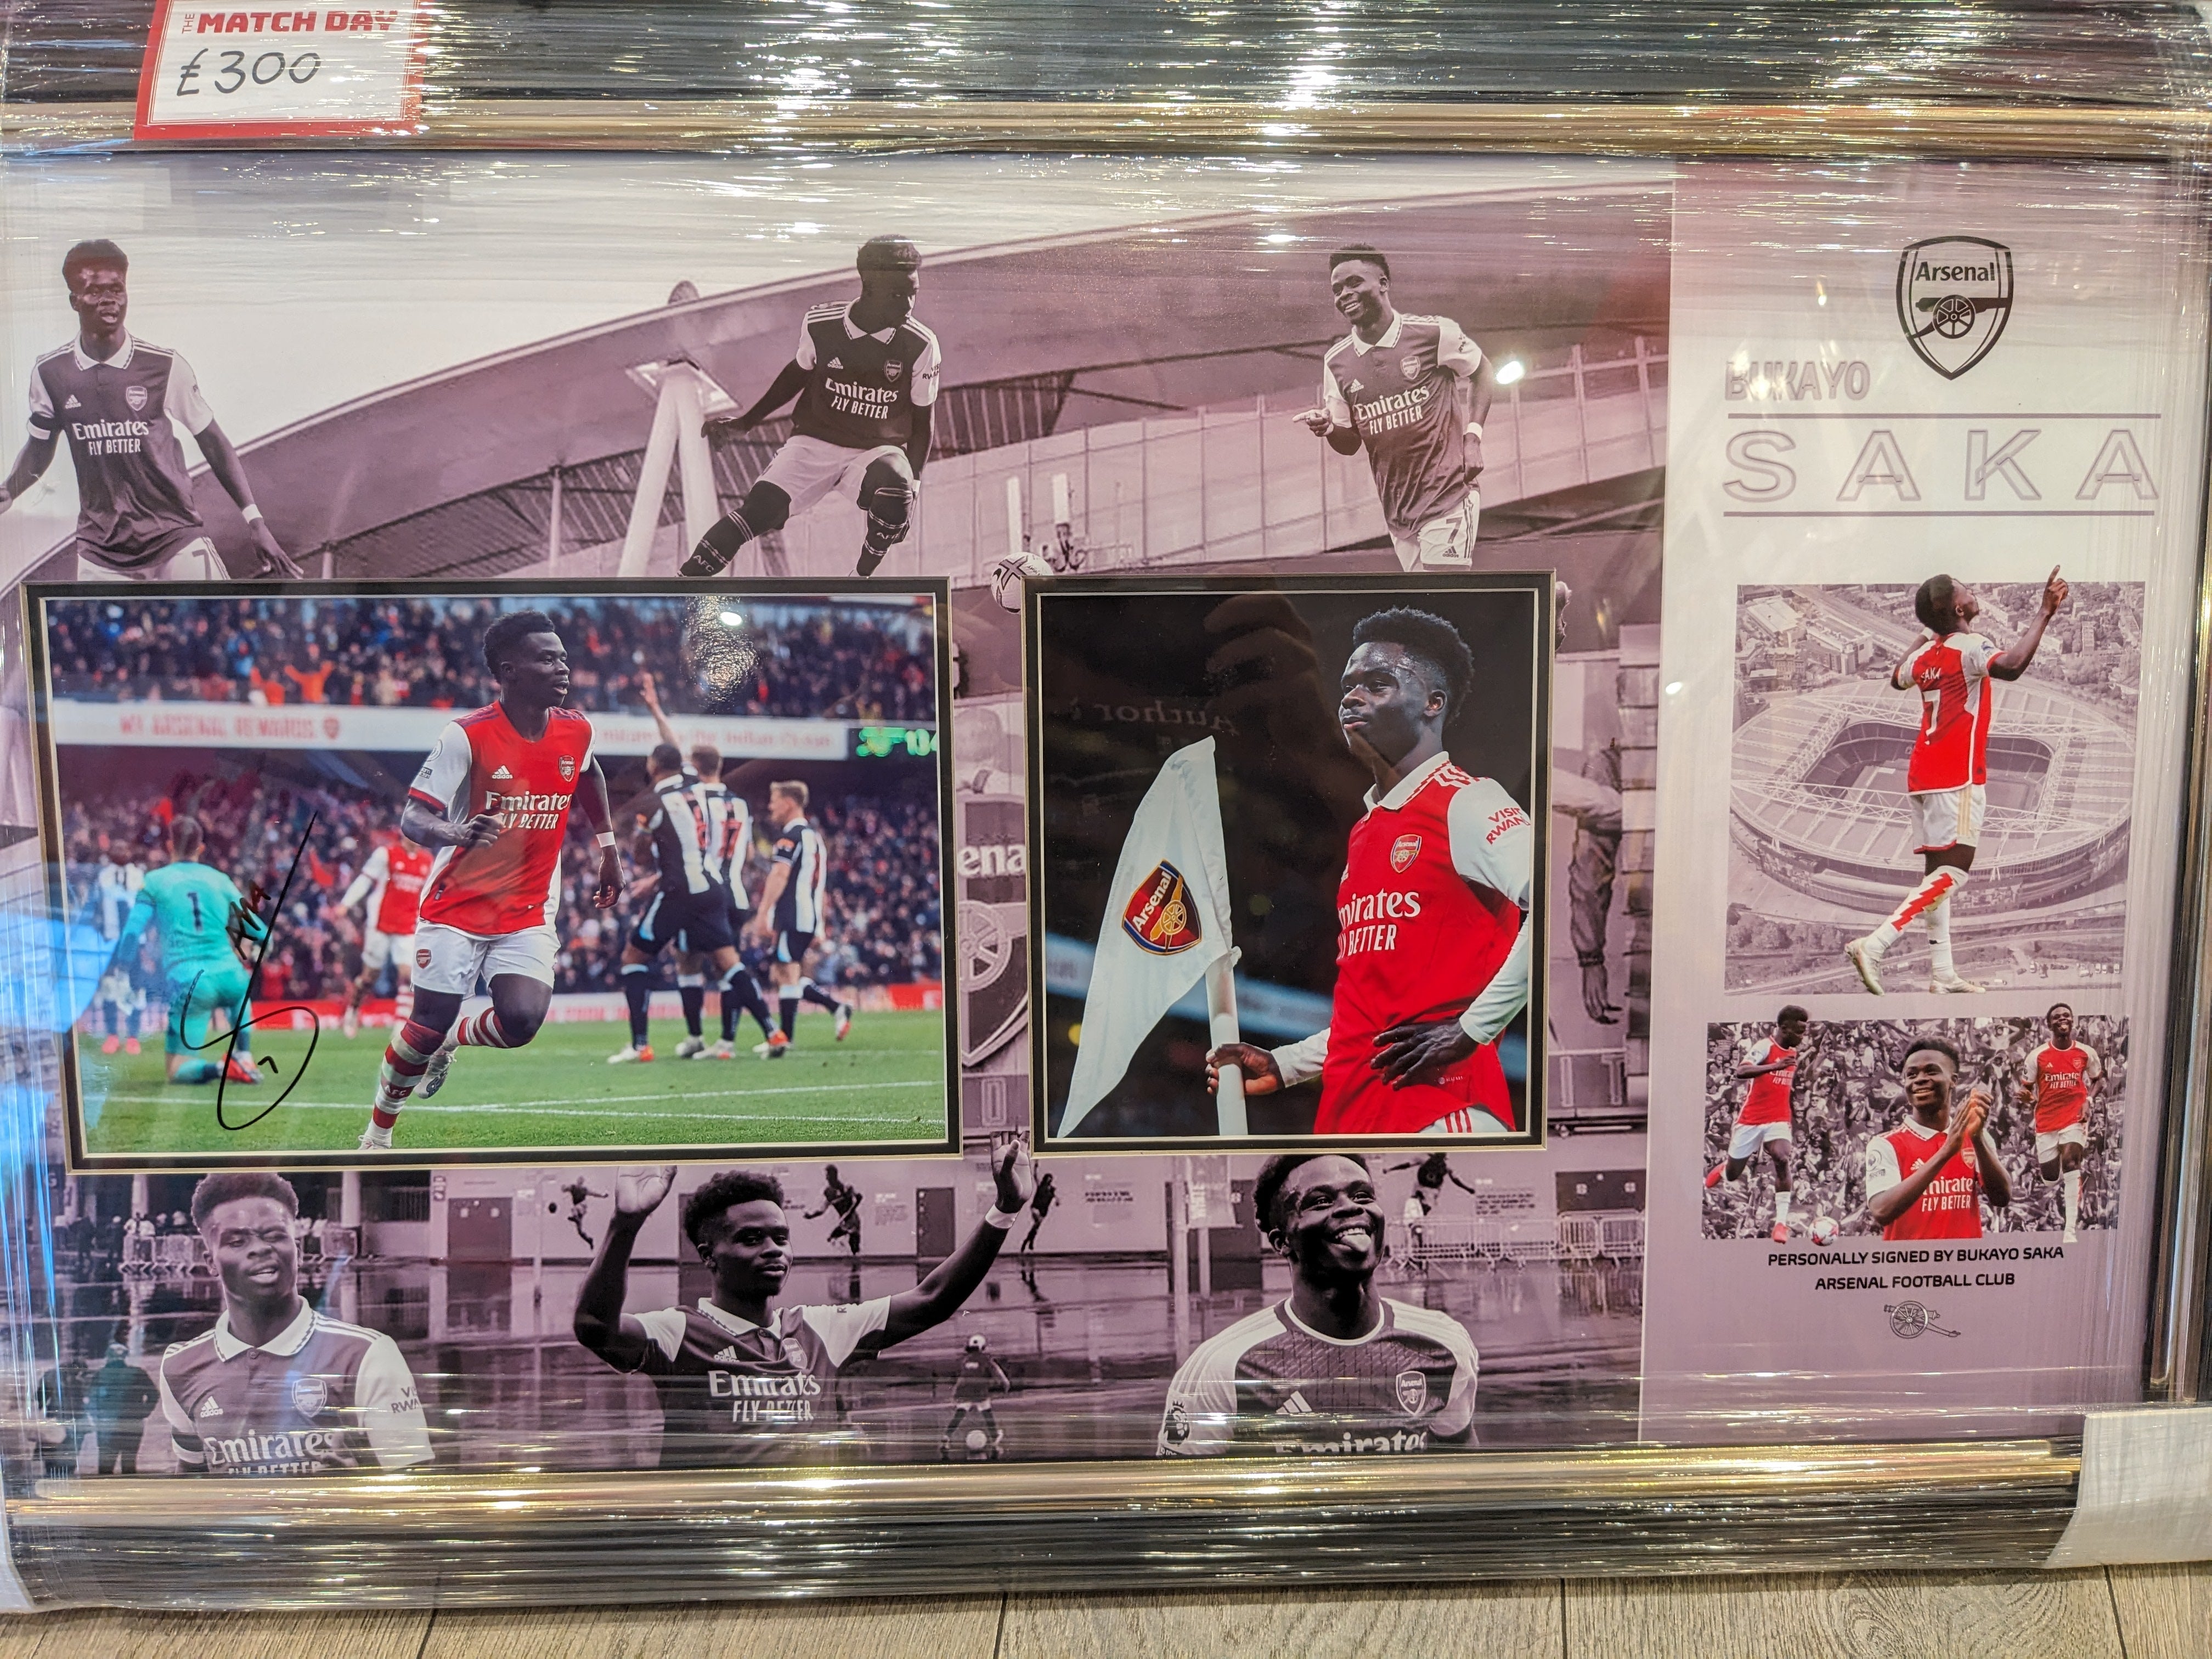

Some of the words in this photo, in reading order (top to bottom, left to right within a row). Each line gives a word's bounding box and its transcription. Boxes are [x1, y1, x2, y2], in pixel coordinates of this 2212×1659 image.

[182, 13, 195, 33] THE
[196, 11, 317, 33] MATCH
[325, 10, 398, 32] DAY
[177, 48, 322, 97] £300
[1915, 261, 1995, 282] Arsenal
[825, 377, 899, 403] Emirates
[1724, 360, 1870, 402] BUKAYO
[831, 396, 850, 411] FLY
[851, 401, 889, 419] BETTER
[1353, 386, 1430, 421] Emirates
[72, 419, 149, 440] Emirates
[1369, 415, 1383, 435] FLY
[1386, 405, 1423, 430] BETTER
[88, 441, 102, 456] FLY
[106, 438, 141, 454] BETTER
[1723, 429, 2159, 503] SAKA
[1446, 516, 1463, 544] 7
[191, 549, 212, 580] 7
[693, 554, 714, 573] AFC
[1922, 689, 1941, 736] 7
[518, 813, 559, 830] BETTER
[1488, 808, 1523, 822] VISIT
[187, 891, 203, 932] 1
[1132, 871, 1172, 933] Arsenal
[1338, 888, 1421, 930] mirates
[1347, 924, 1397, 956] BETTER
[2045, 1072, 2079, 1082] Emirate
[385, 1085, 407, 1096] AFC
[1922, 1176, 1973, 1195] mirate
[1922, 1198, 1939, 1212] FLY
[1942, 1195, 1971, 1210] BETTER
[1768, 1252, 1869, 1266] PERSONALLY
[1871, 1250, 1929, 1264] SIGNED
[1934, 1249, 1954, 1262] BY
[1957, 1248, 2019, 1261] BUKAYO
[2023, 1246, 2064, 1260] SAKA
[1815, 1276, 1888, 1290] ARSENAL
[1892, 1274, 1972, 1288] FOOTBALL
[1976, 1273, 2015, 1286] CLUB
[1401, 1379, 1422, 1387] Arsenal
[200, 1408, 224, 1418] adidas
[732, 1400, 760, 1422] FLY
